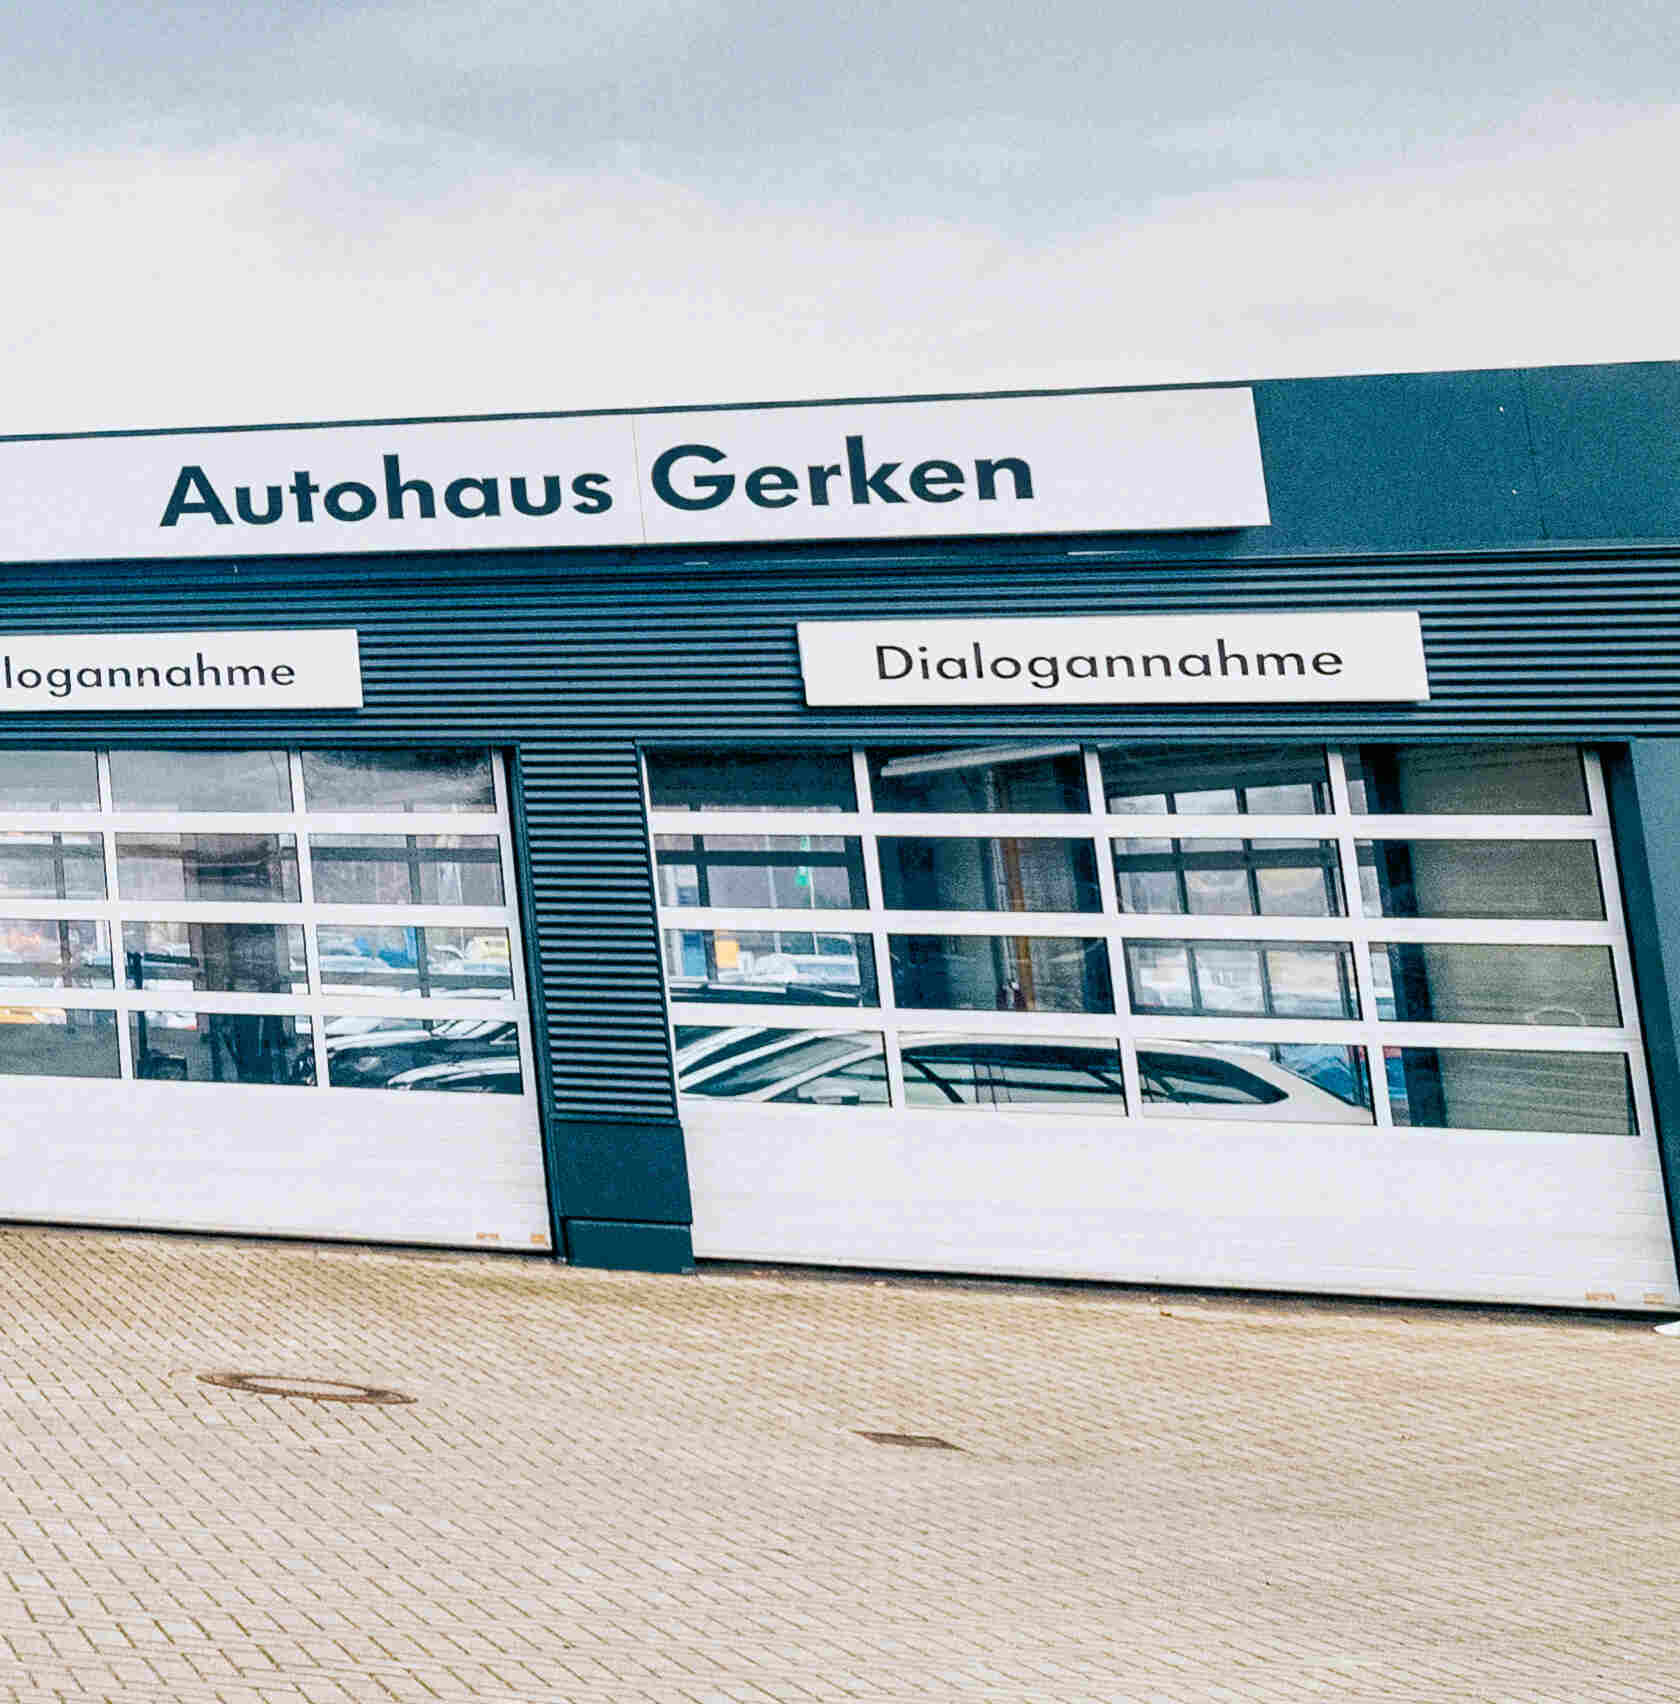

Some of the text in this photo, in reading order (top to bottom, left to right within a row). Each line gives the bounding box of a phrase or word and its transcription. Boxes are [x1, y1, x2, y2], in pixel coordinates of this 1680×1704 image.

[159, 435, 1036, 527] Autohaus Gerken
[873, 638, 1344, 689] Dialogannahme
